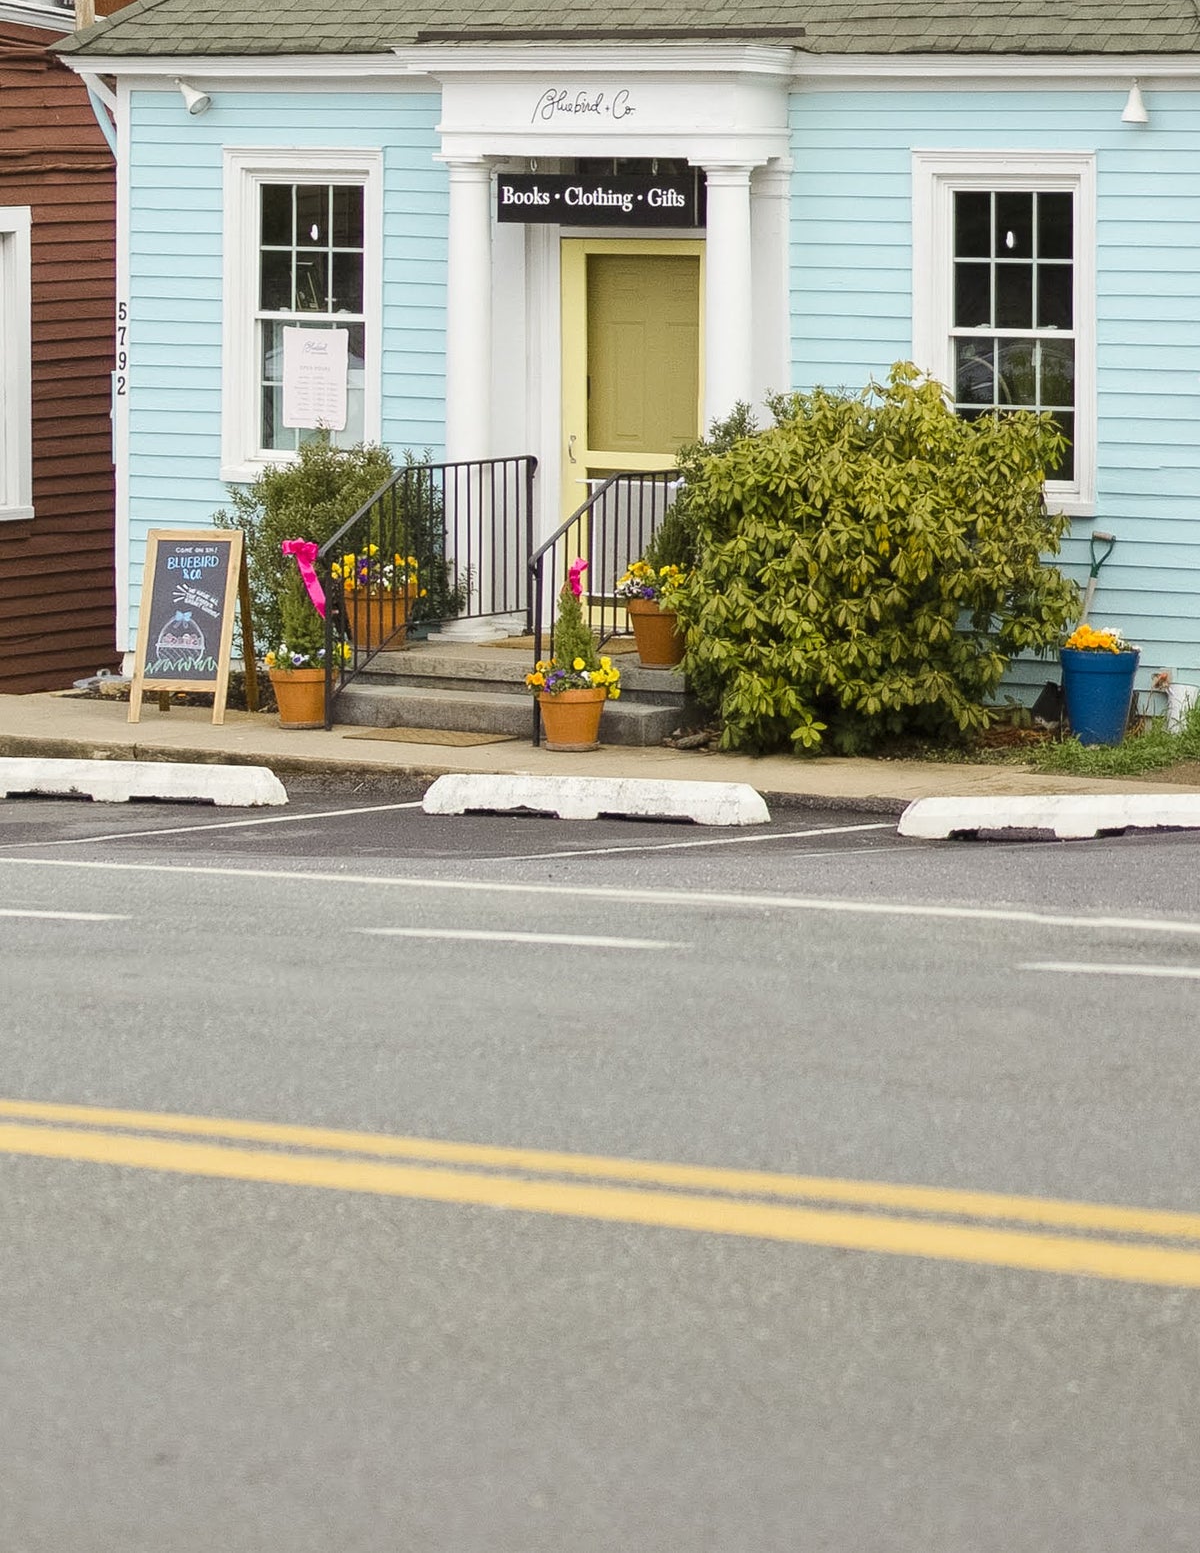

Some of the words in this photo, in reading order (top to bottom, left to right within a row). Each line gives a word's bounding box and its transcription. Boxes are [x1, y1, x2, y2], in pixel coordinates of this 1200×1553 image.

[531, 88, 603, 123] Bluebird
[612, 89, 636, 119] Co.
[502, 186, 550, 206] Books
[564, 187, 633, 212] Clothing
[647, 188, 685, 208] Gifts
[167, 555, 219, 569] BLUEBIRD
